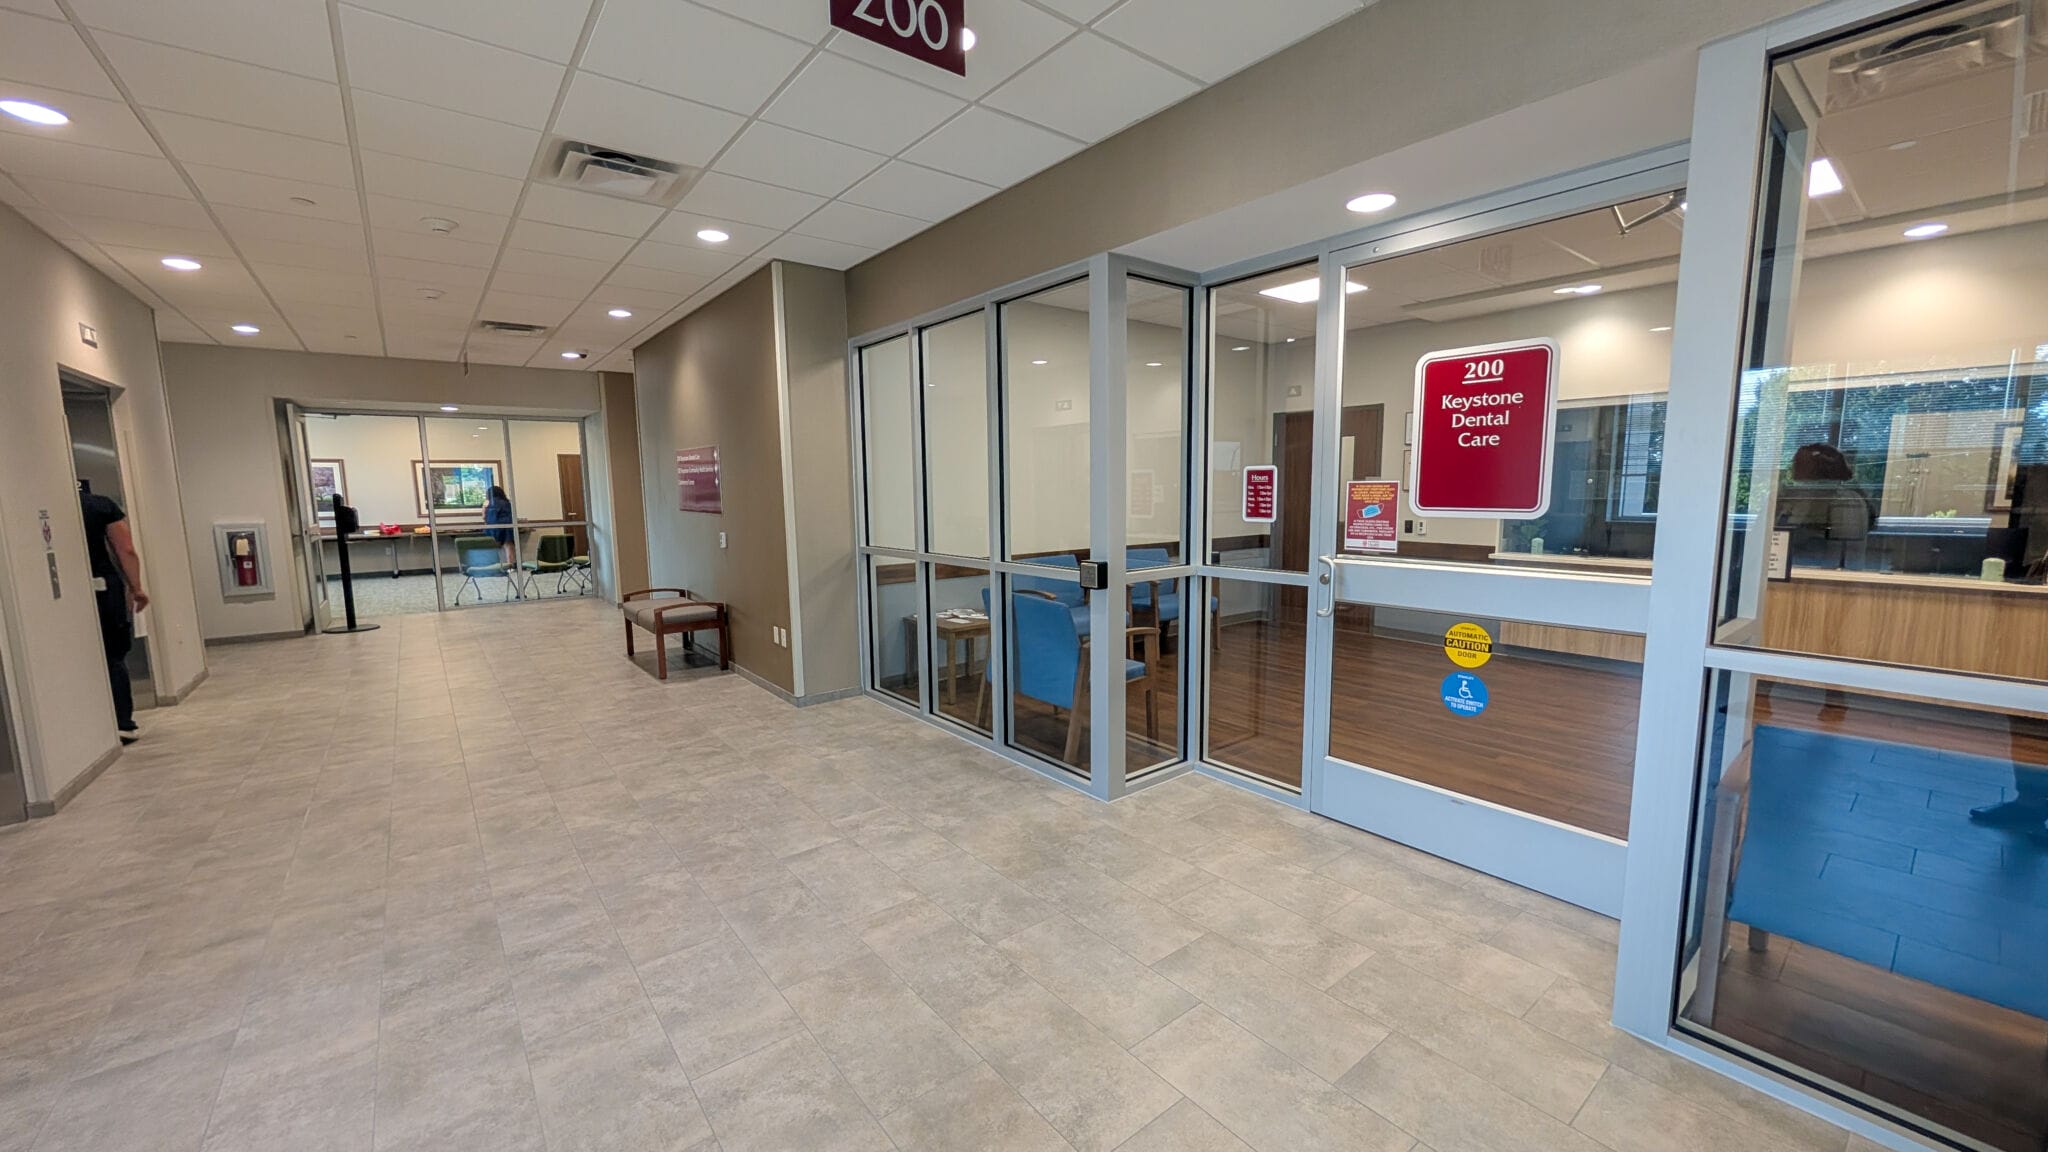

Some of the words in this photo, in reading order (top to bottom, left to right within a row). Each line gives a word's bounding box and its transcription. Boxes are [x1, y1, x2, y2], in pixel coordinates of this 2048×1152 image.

[1464, 359, 1504, 379] 200
[1441, 391, 1524, 412] Keystone
[1451, 410, 1510, 428] Dental
[1457, 432, 1501, 447] Care
[1448, 630, 1489, 641] AUTOMATIC
[1446, 639, 1489, 652] CAUTION
[1457, 650, 1477, 659] DOOR
[1457, 703, 1477, 712] OPERATE
